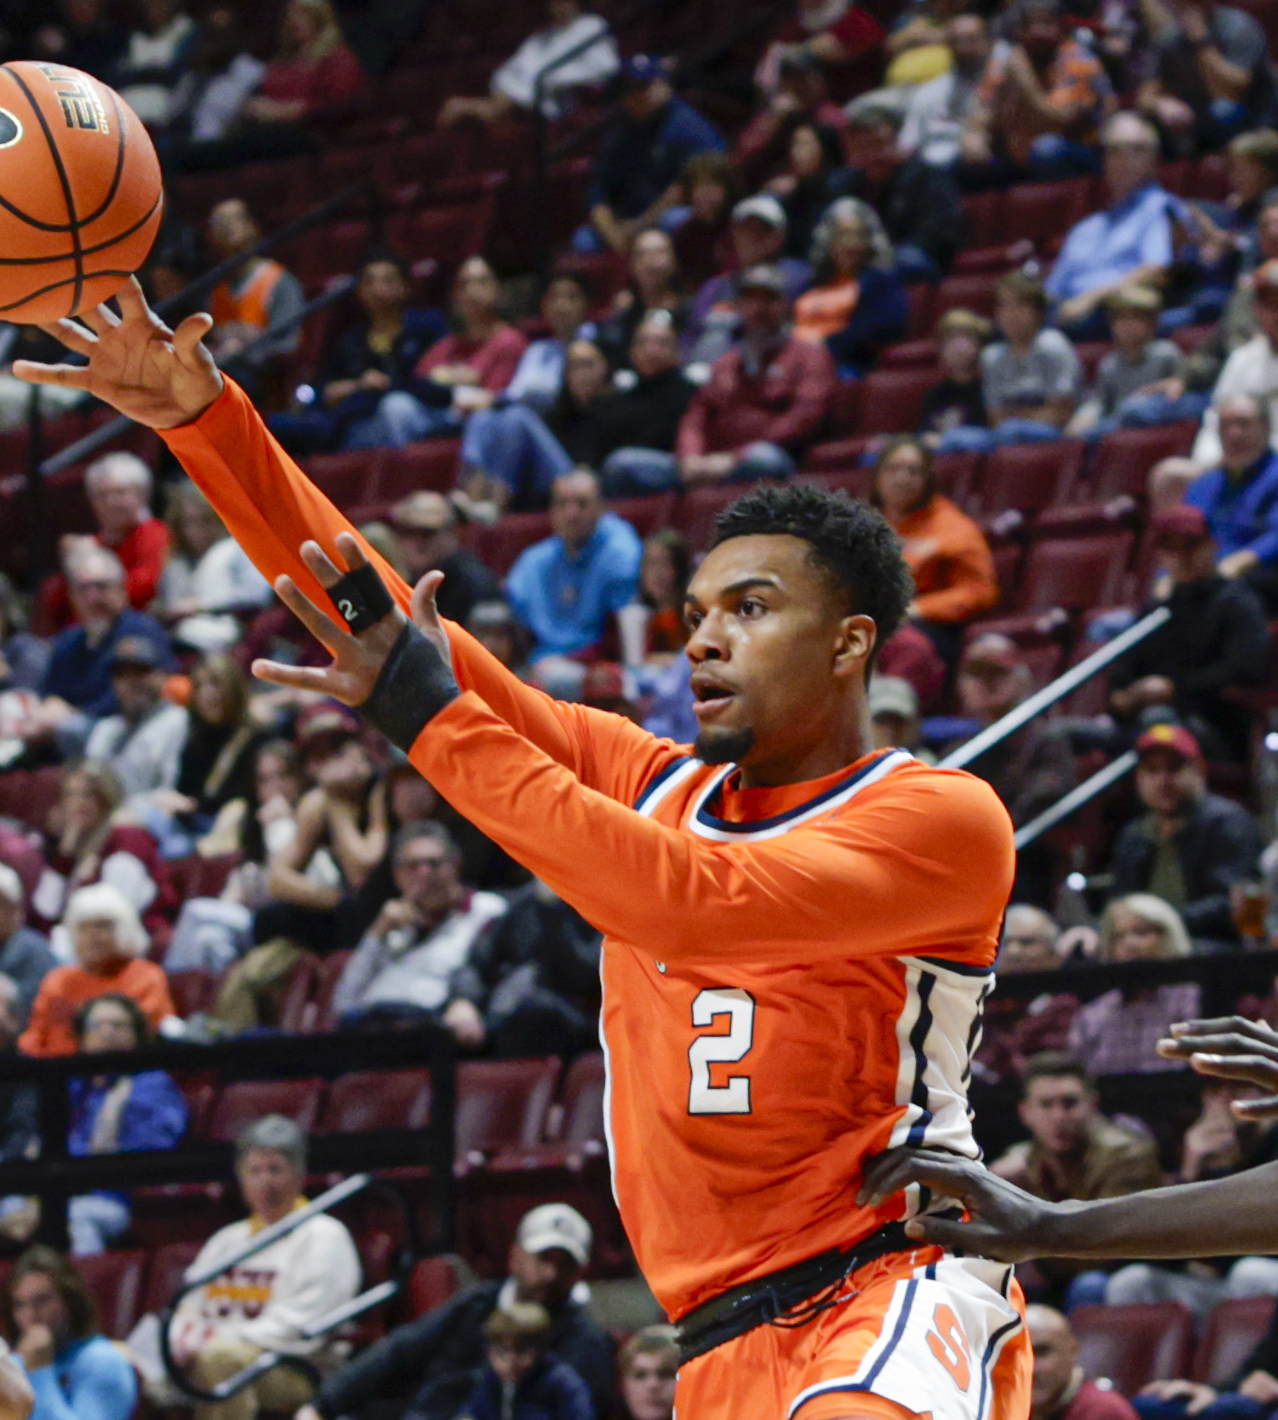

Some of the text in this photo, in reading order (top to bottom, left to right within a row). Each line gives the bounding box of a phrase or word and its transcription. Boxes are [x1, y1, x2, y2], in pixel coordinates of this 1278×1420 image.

[338, 599, 359, 621] 2
[688, 986, 756, 1115] 2
[925, 1303, 971, 1392] S
